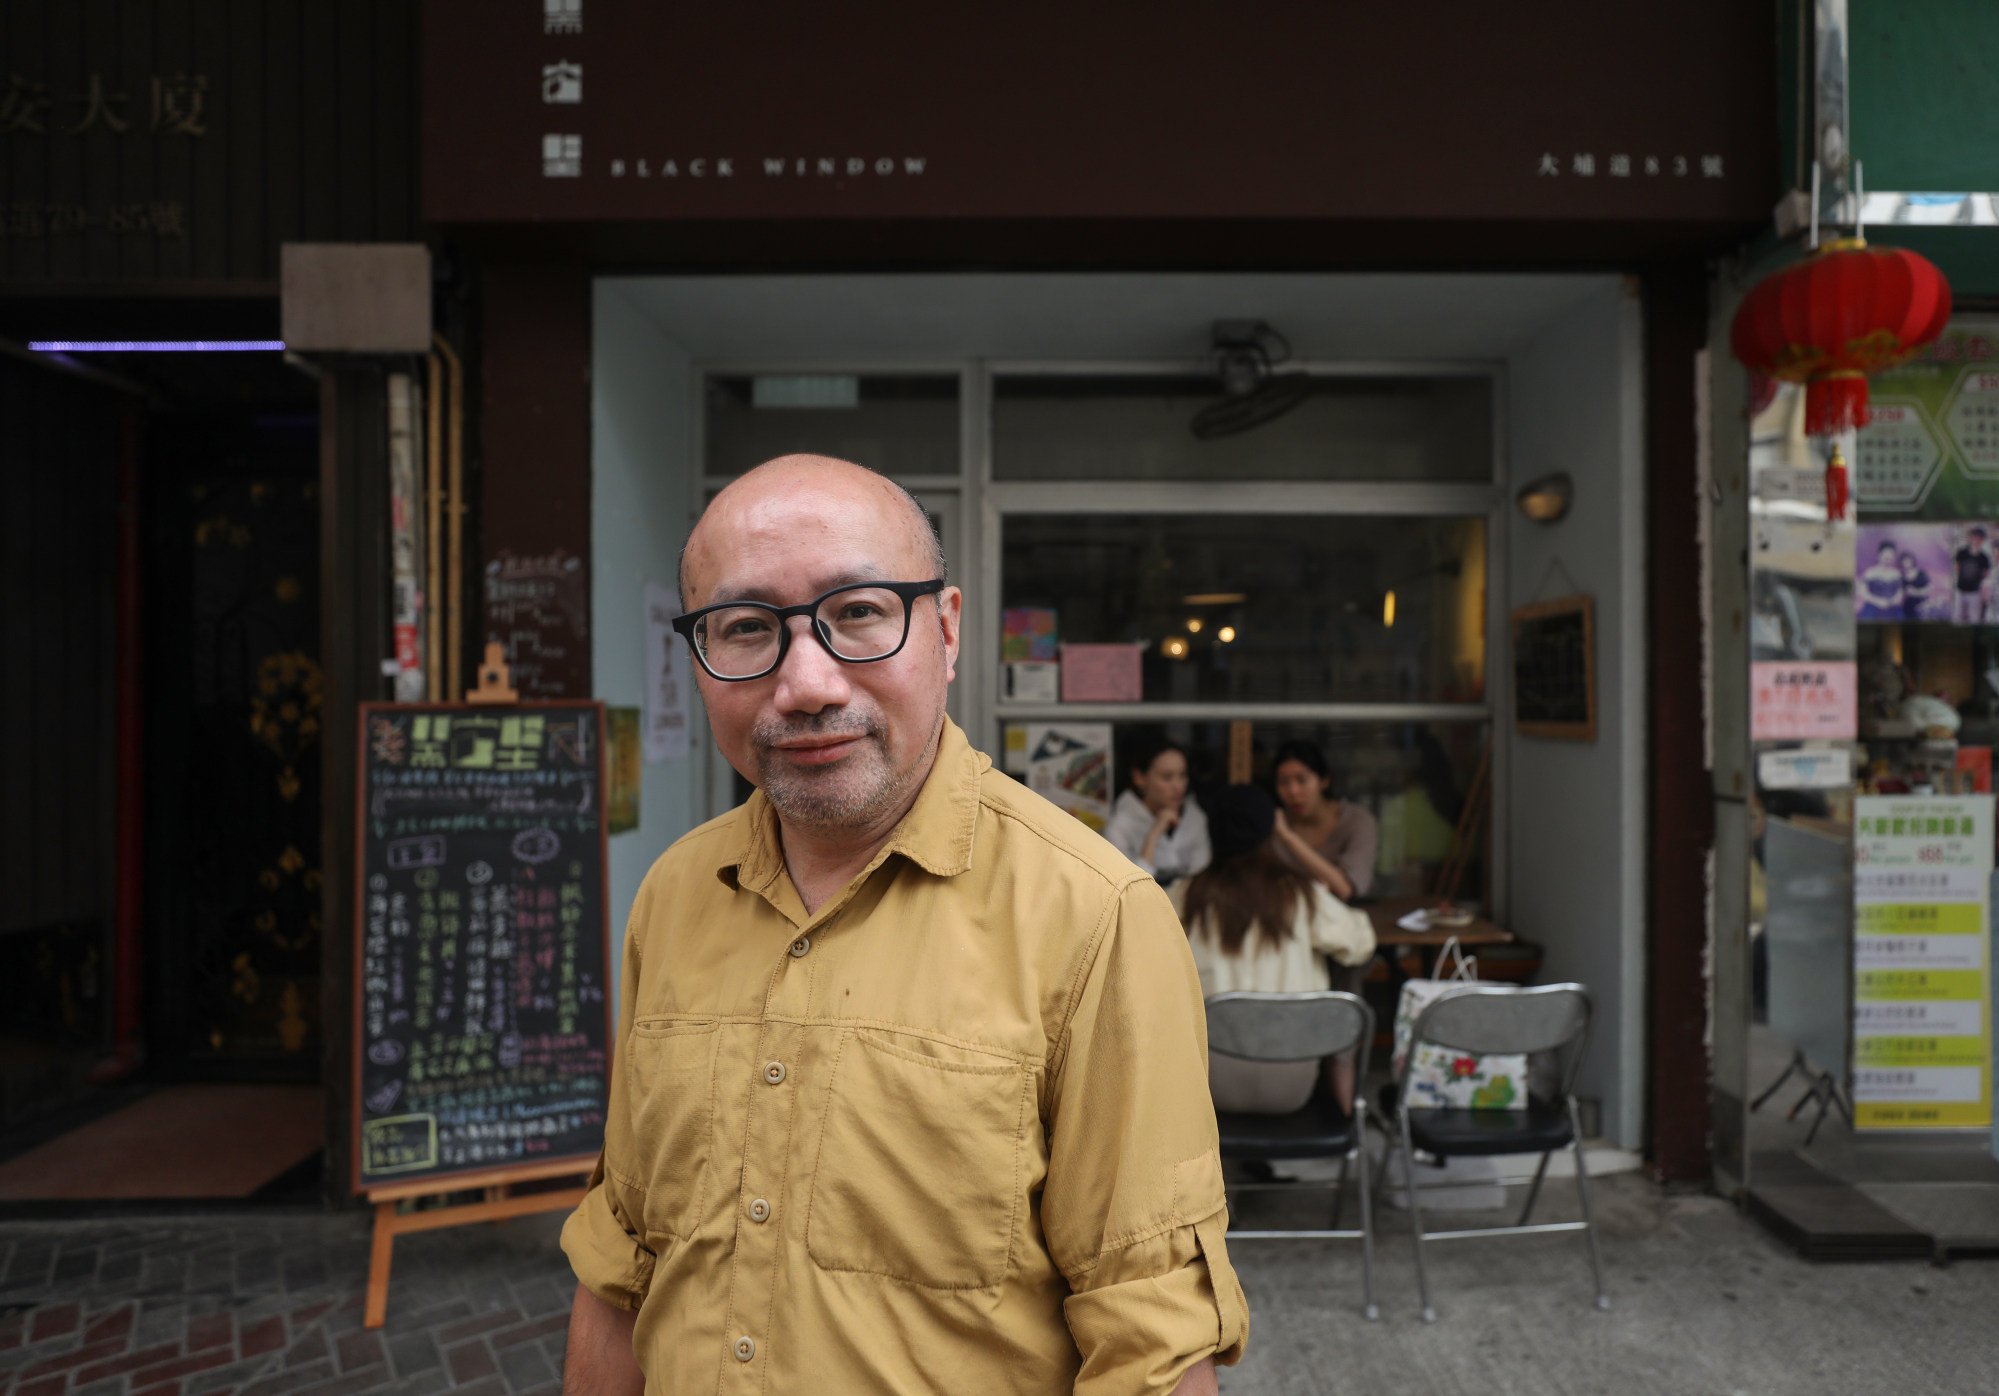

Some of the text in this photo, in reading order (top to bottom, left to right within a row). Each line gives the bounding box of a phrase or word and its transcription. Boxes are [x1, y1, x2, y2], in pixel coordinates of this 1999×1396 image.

[610, 157, 928, 178] BLACK WINDOW
[1537, 152, 1726, 178] 大埔道83號
